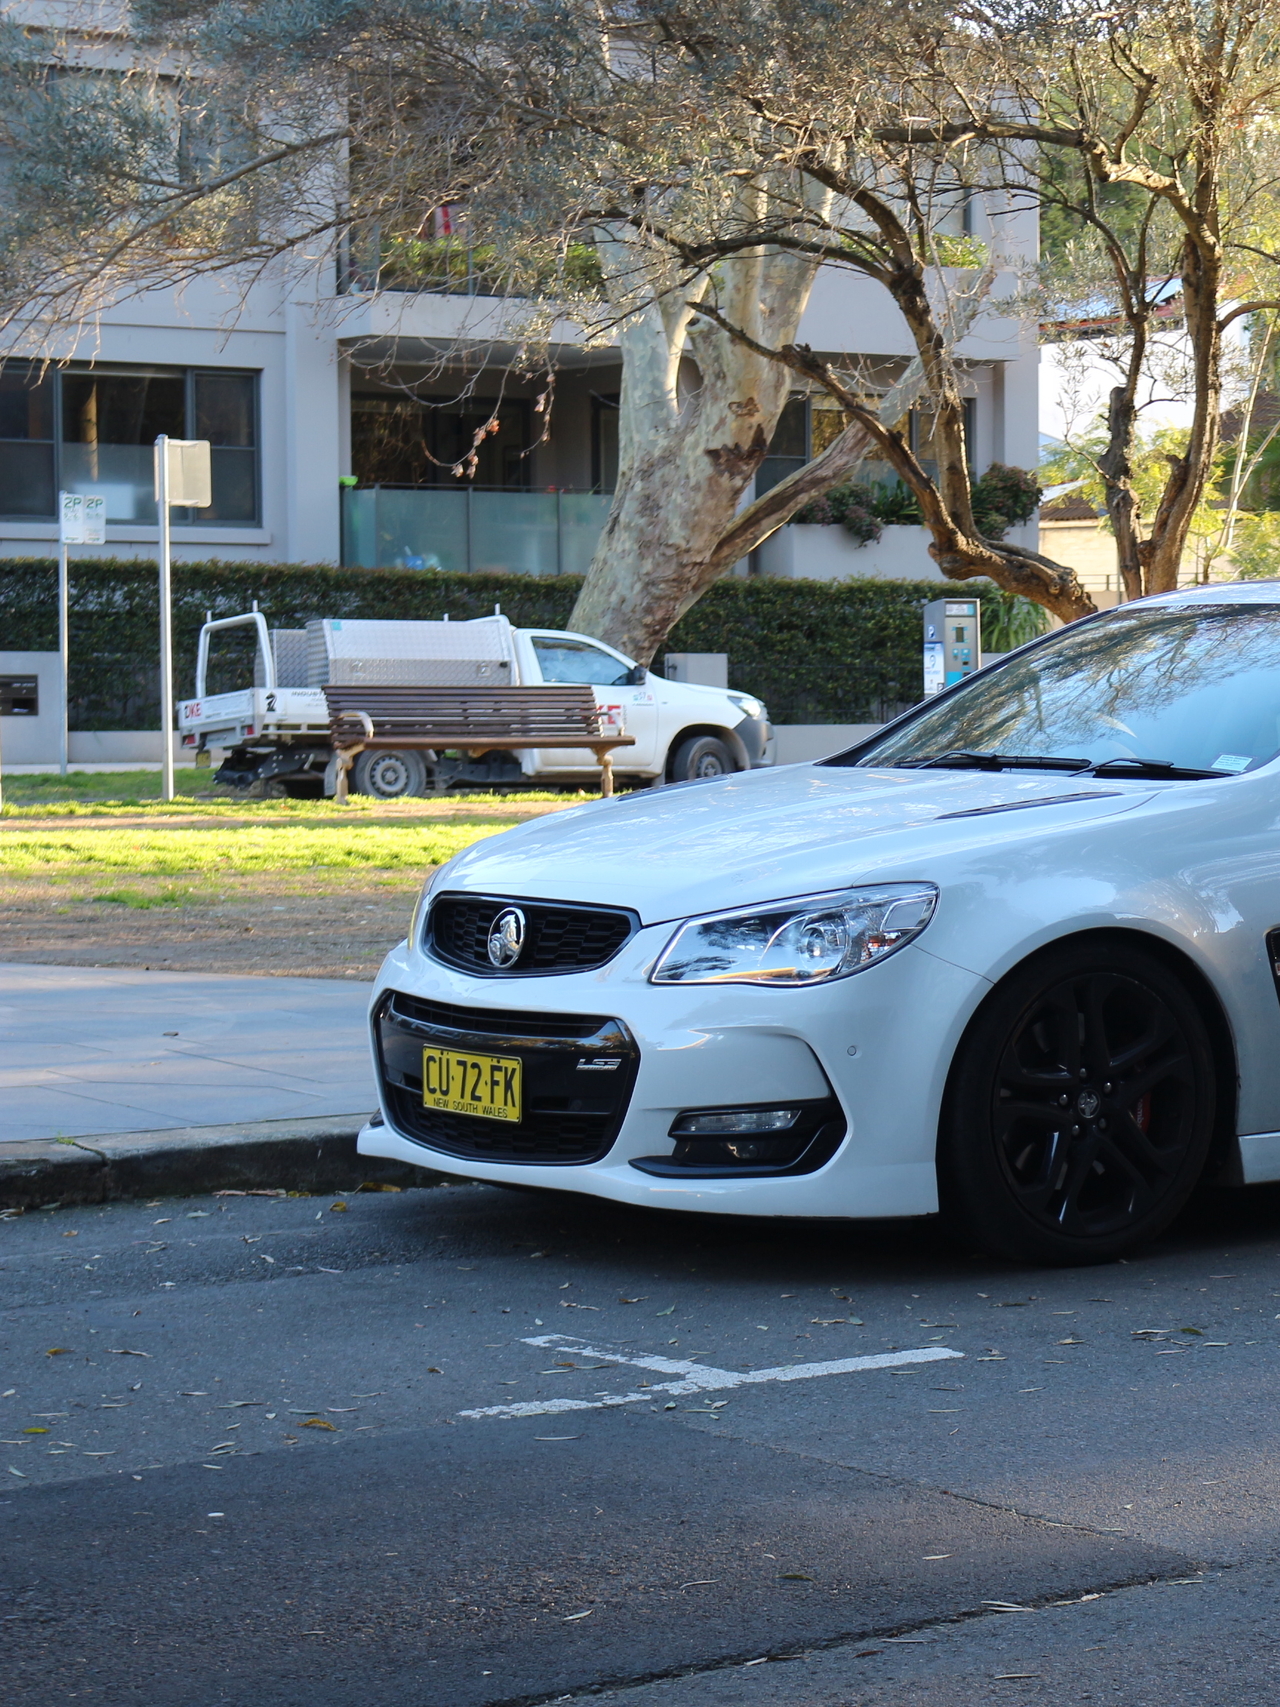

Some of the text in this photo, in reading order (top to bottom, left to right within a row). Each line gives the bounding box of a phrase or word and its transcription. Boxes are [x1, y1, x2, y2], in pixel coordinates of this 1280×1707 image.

[64, 496, 82, 509] 2P
[86, 498, 103, 509] 2P
[433, 1097, 508, 1118] NEW SOUTH WALES
